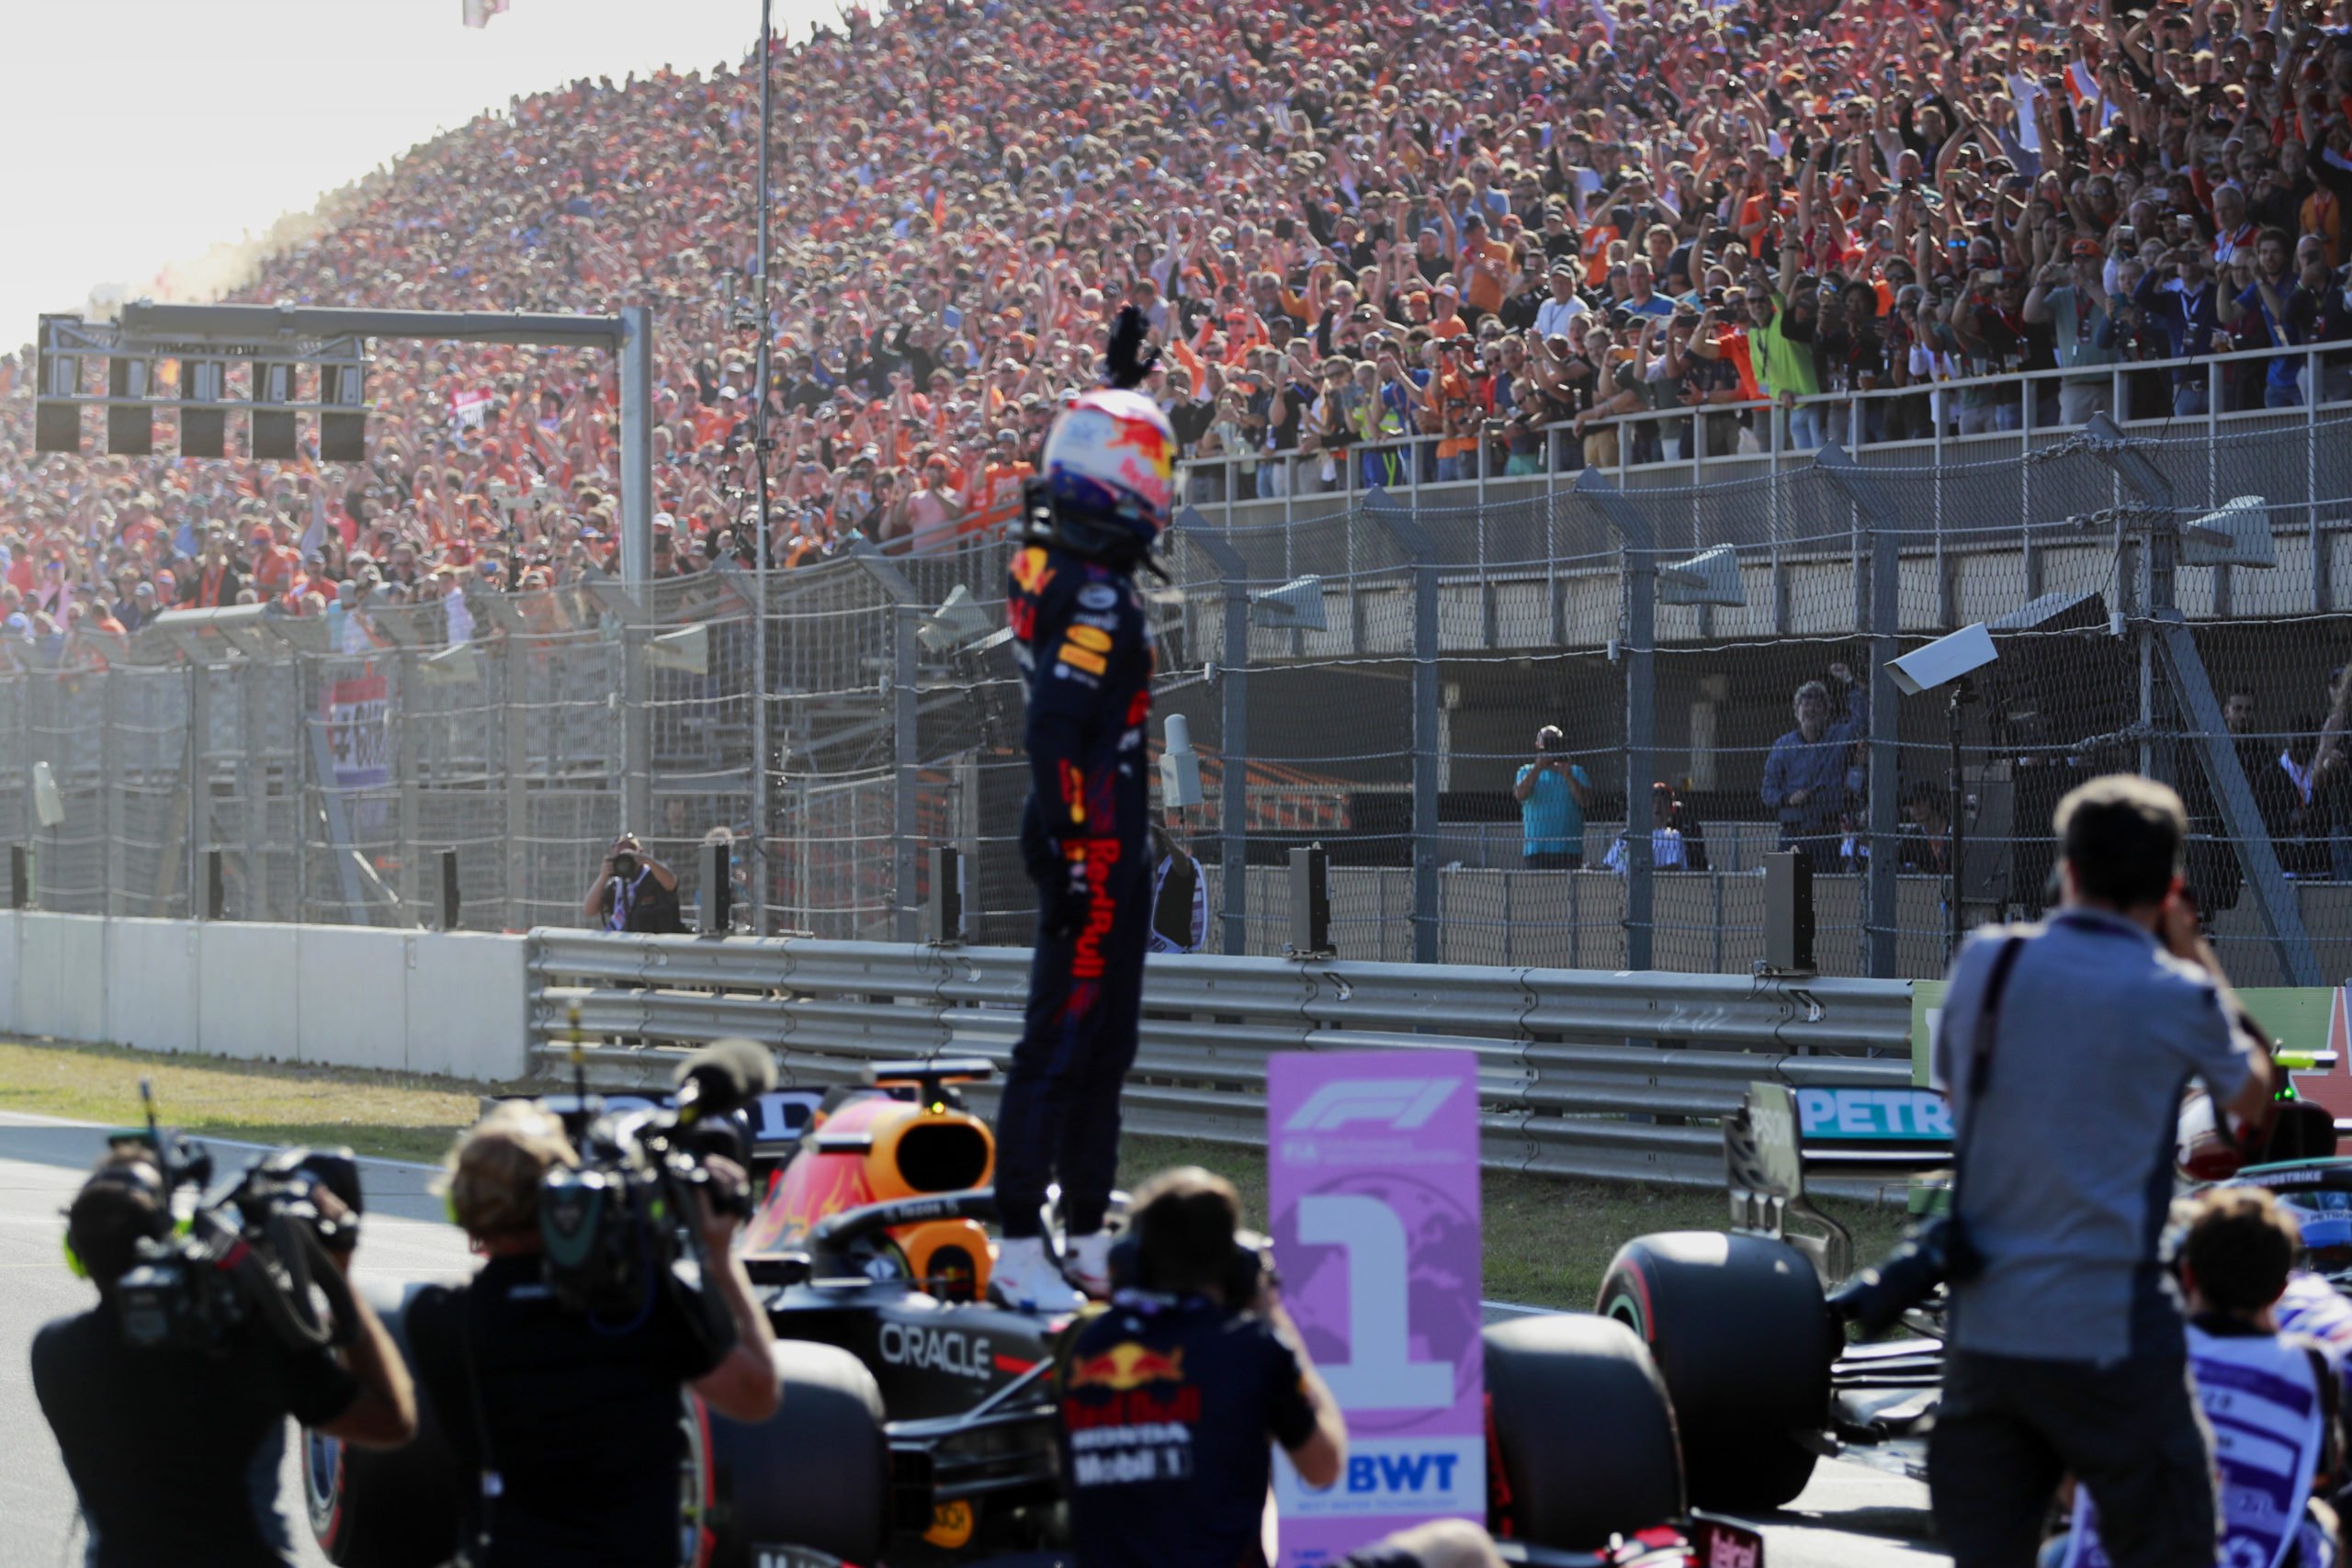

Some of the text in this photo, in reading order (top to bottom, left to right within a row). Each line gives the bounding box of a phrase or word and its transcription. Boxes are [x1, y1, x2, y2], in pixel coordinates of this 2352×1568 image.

[1297, 1195, 1454, 1409] 1
[879, 1322, 991, 1381] ORACLE
[1075, 1449, 1157, 1487] Mobil
[1347, 1453, 1458, 1493] BWT
